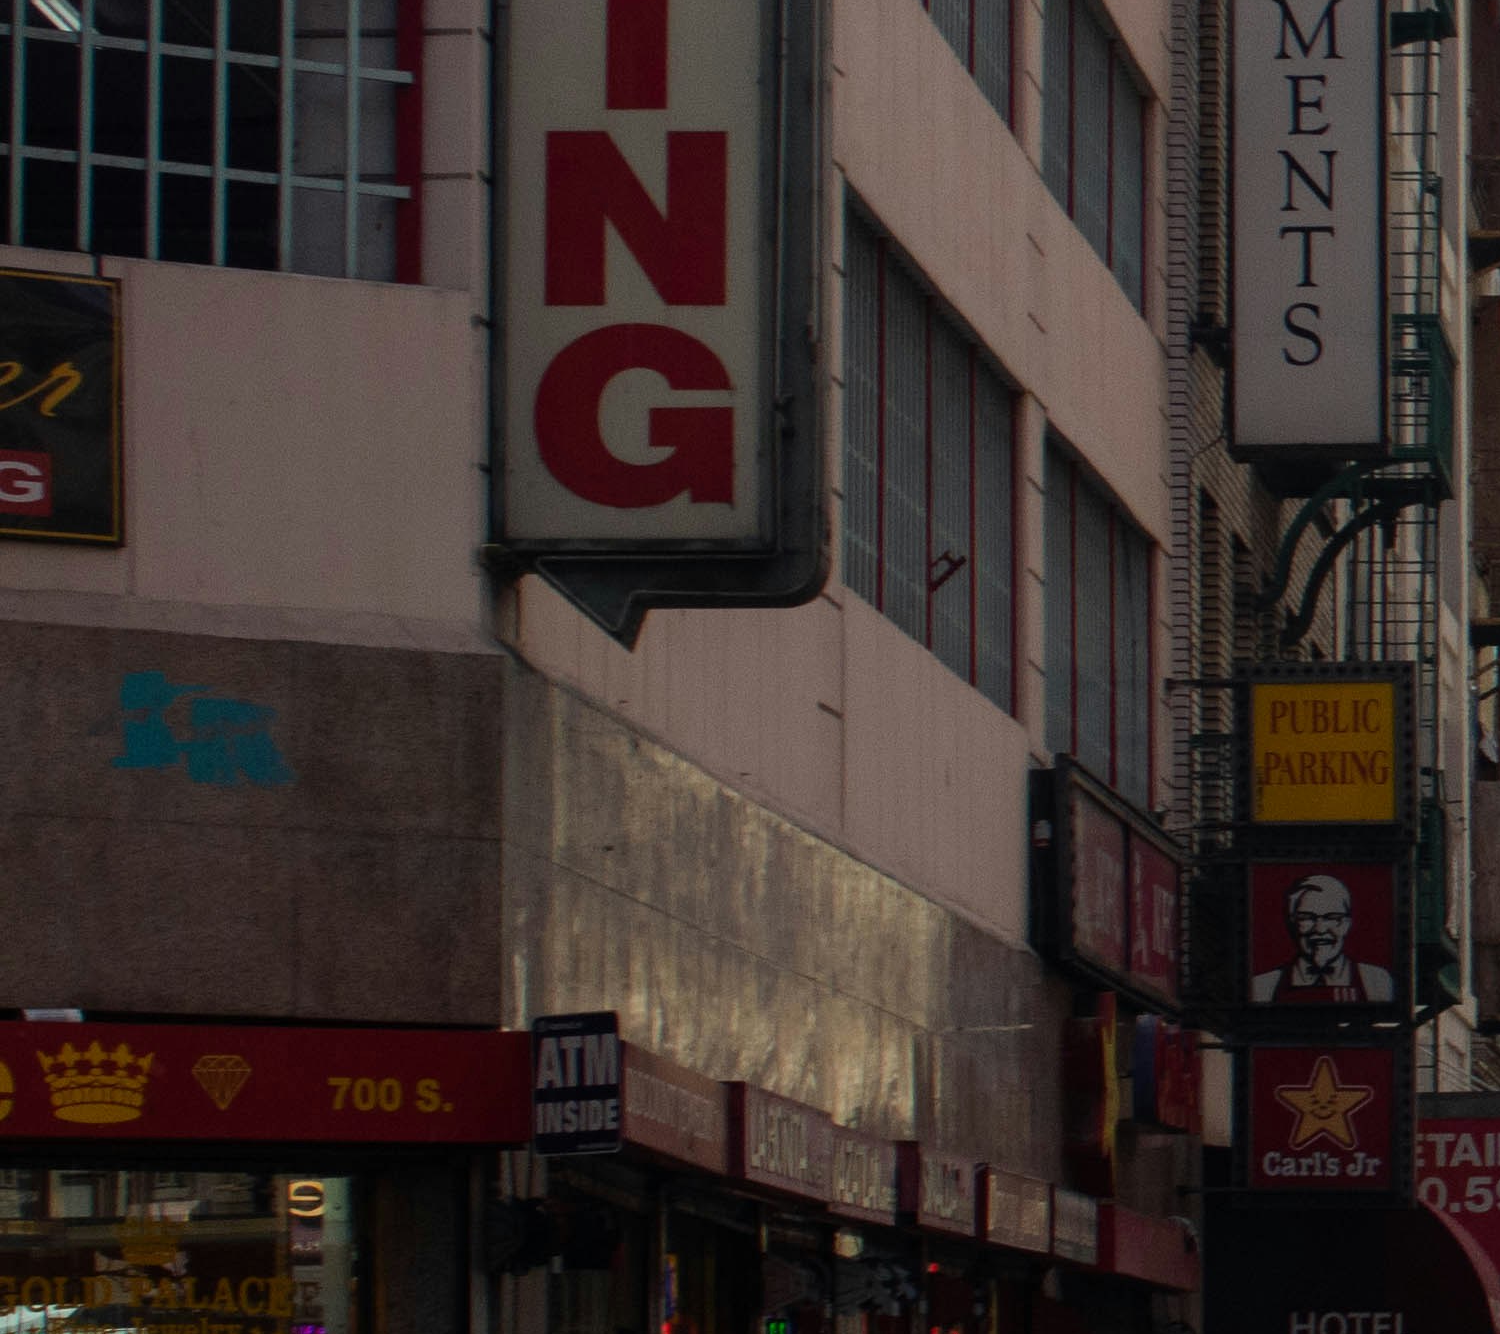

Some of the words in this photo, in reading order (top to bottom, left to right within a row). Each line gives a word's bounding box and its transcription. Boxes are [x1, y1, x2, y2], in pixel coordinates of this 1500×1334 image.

[1269, 698, 1381, 735] PUBLIC
[1262, 750, 1391, 786] PARKING
[536, 1033, 618, 1089] ATM
[328, 1077, 402, 1113] 700
[416, 1077, 454, 1113] S.
[536, 1097, 619, 1134] INSIDE
[1262, 1151, 1341, 1178] Carl's
[1344, 1152, 1384, 1178] Jr
[131, 1275, 295, 1317] PALACE
